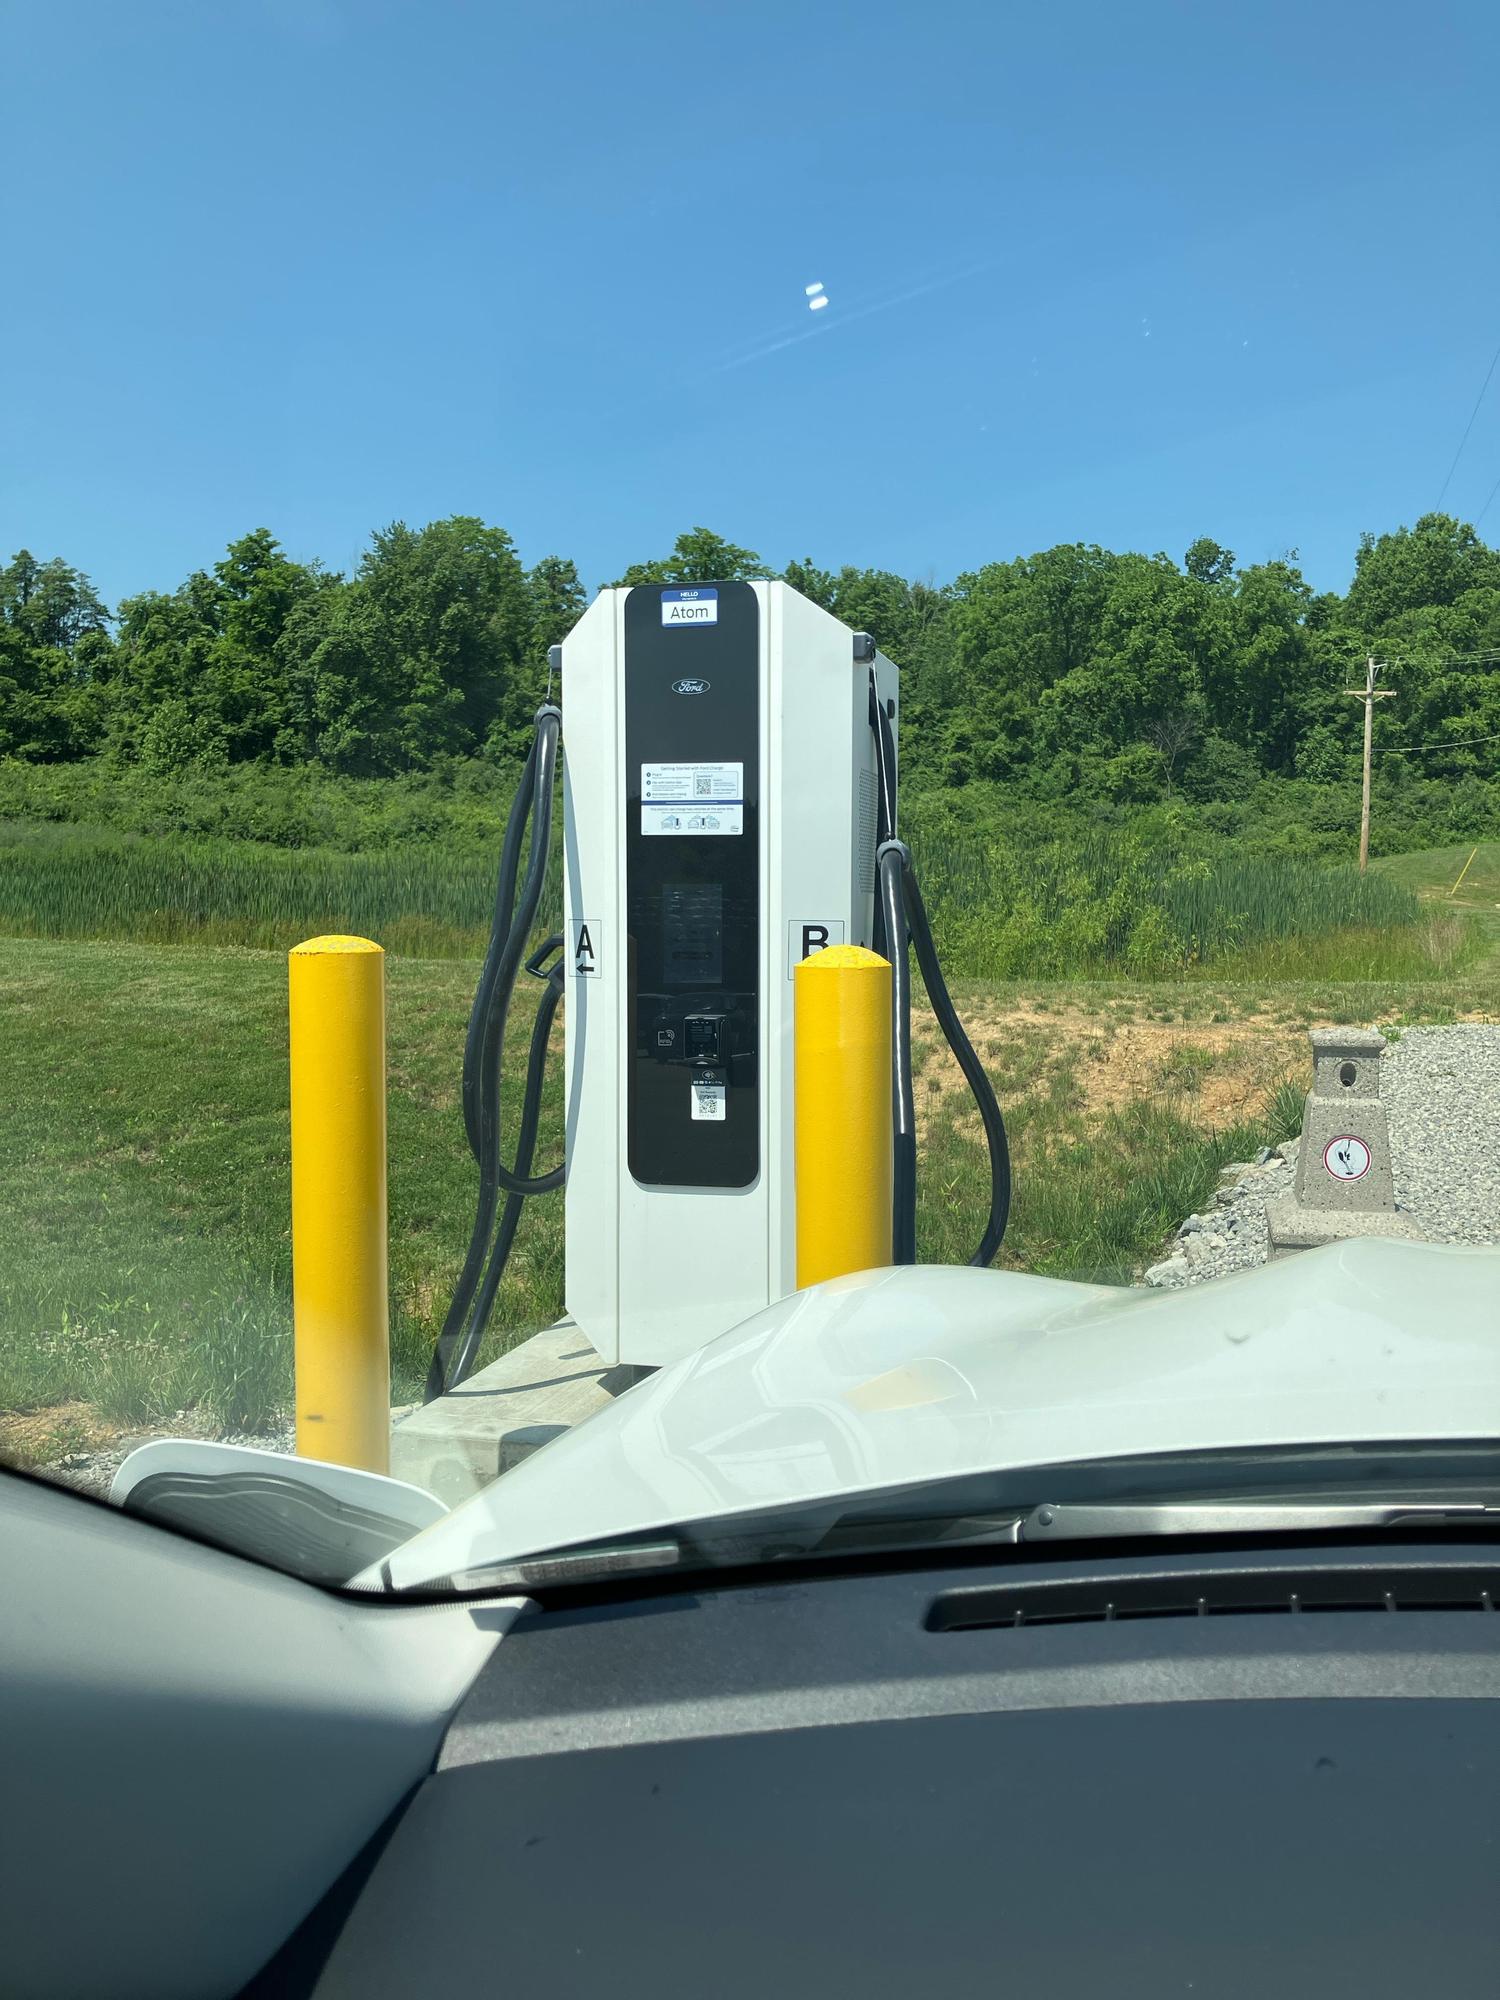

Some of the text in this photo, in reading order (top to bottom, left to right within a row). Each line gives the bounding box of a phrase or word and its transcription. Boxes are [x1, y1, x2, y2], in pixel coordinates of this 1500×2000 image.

[670, 606, 709, 619] Atom
[678, 680, 703, 692] Ford
[576, 925, 594, 959] A
[802, 925, 829, 960] B
